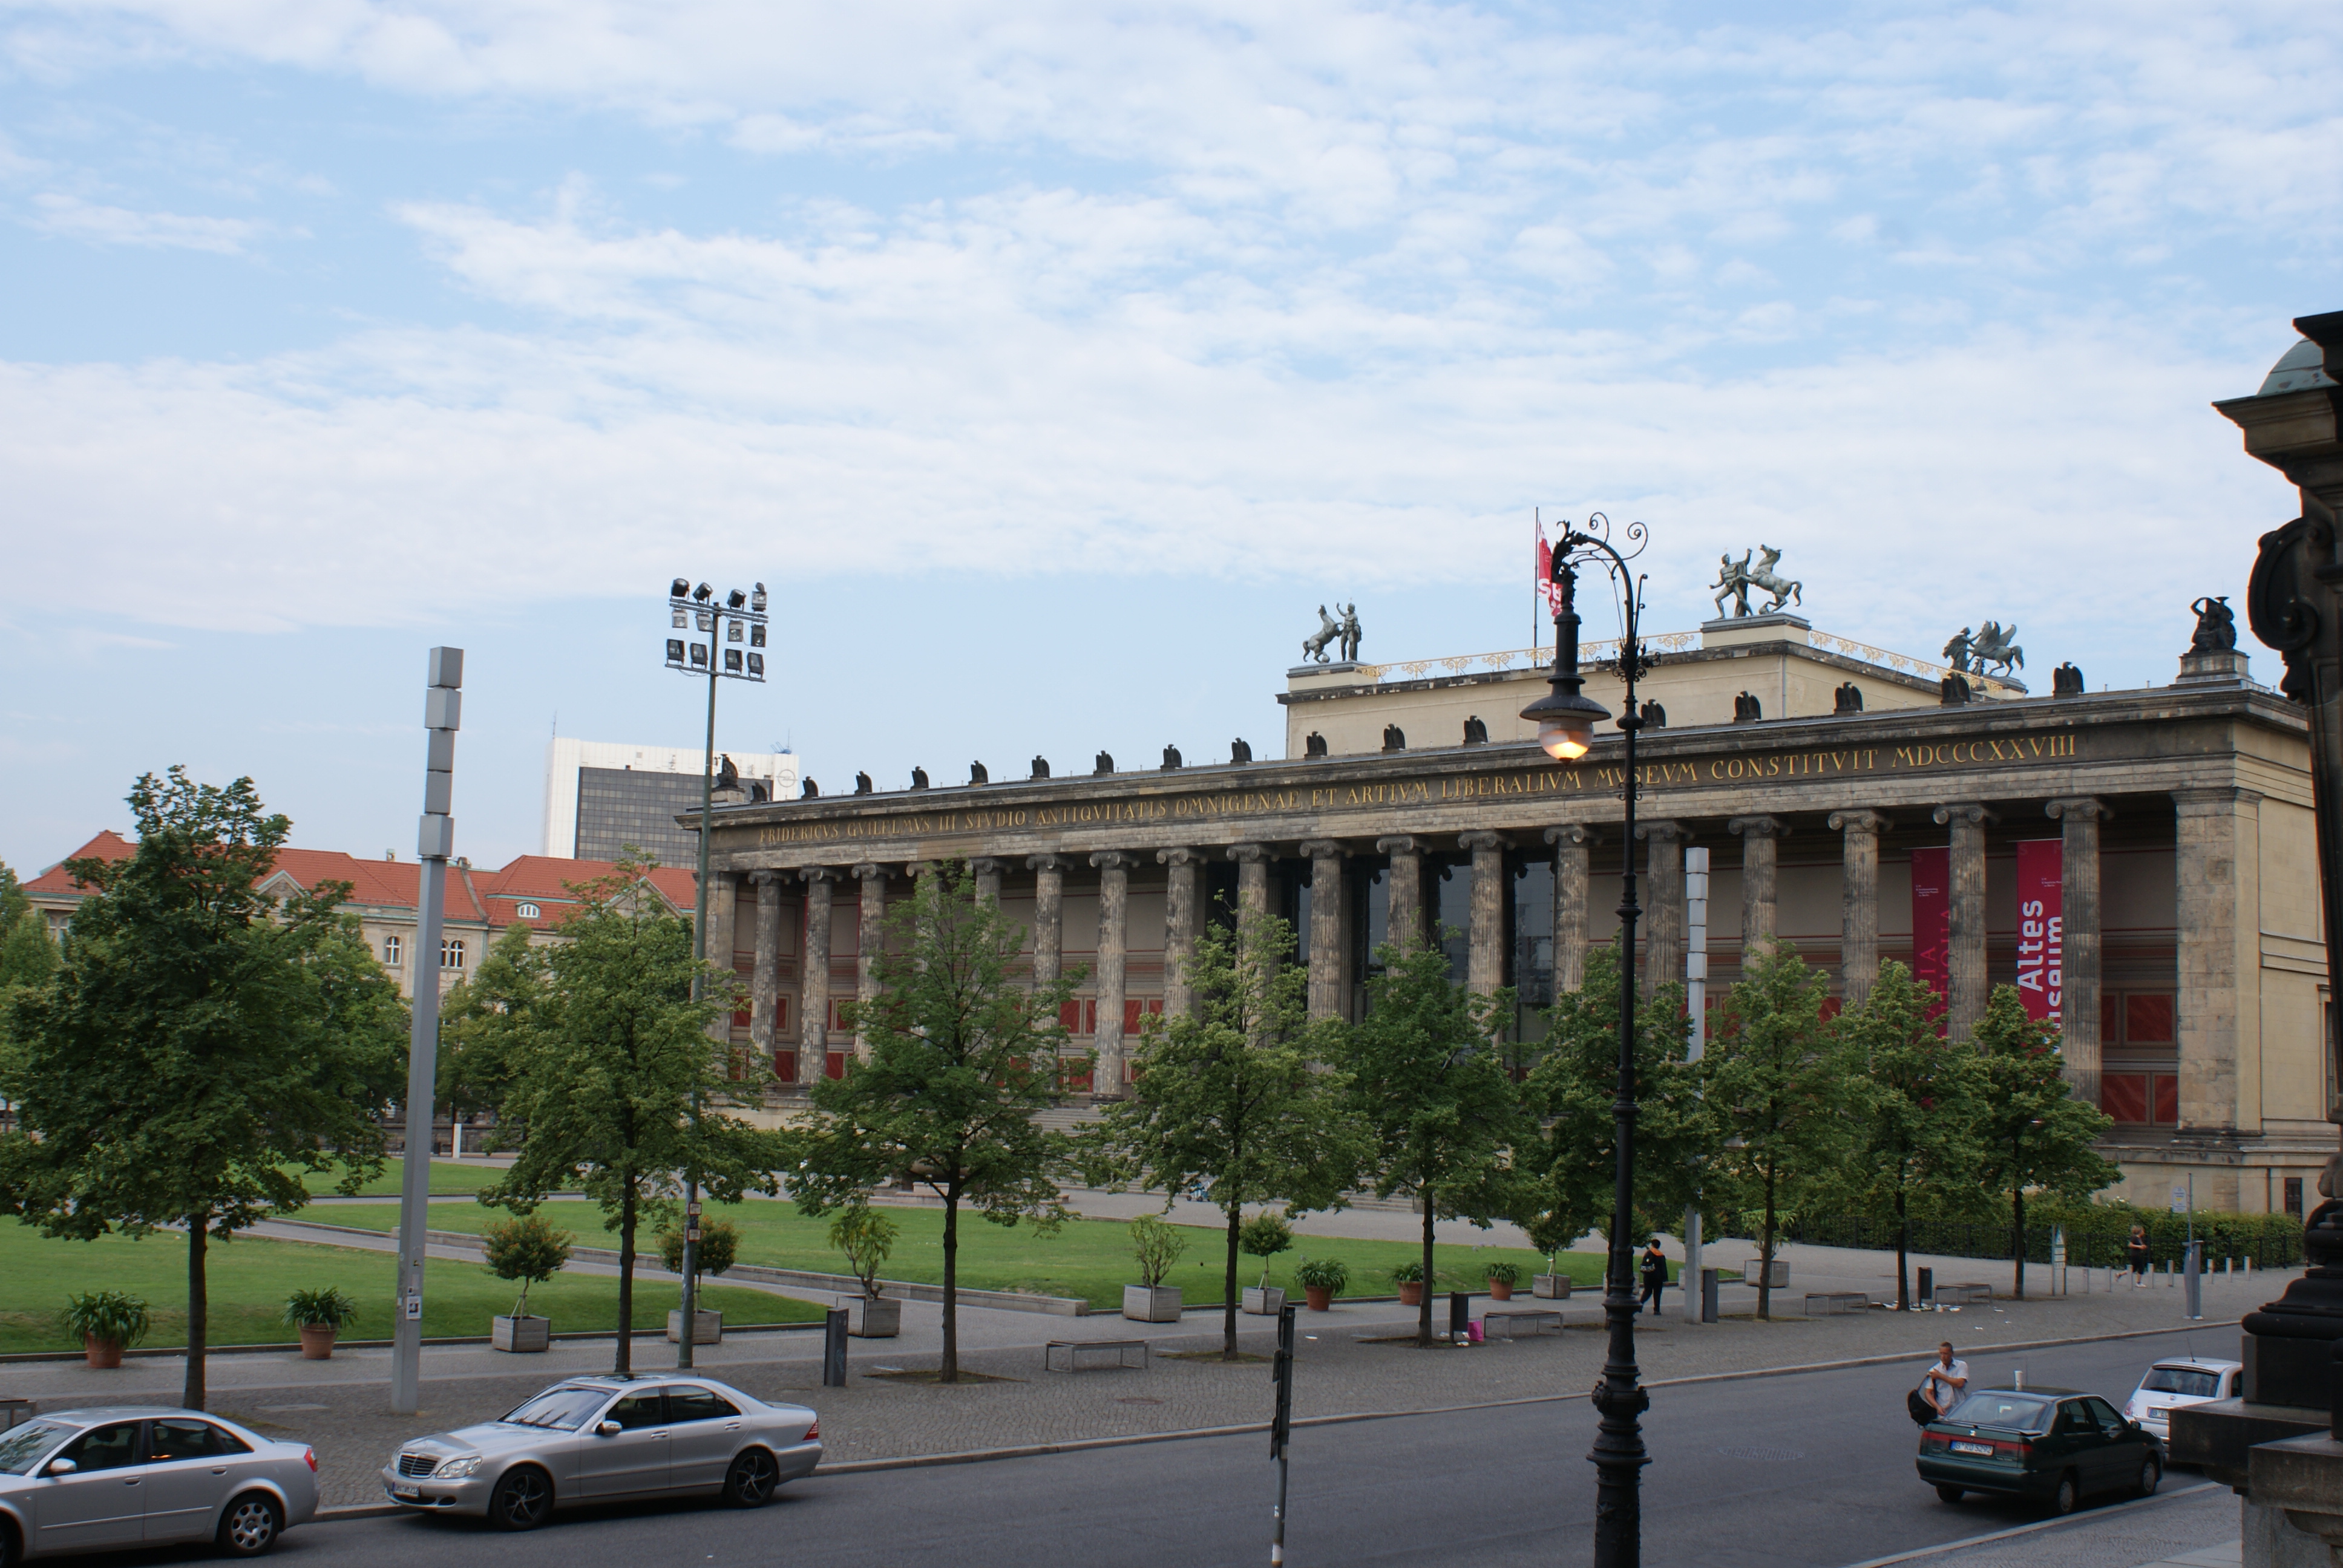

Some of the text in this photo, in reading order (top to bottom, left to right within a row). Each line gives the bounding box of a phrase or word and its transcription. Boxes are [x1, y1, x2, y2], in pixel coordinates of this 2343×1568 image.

[760, 823, 839, 843] FRIDERICVS
[847, 817, 931, 837] GVILELMVS
[939, 815, 956, 831] III
[965, 811, 1026, 829] STVDIO
[1035, 800, 1167, 825] ANTIQVITATIS
[1175, 789, 1301, 815] OMNIGENAE
[1312, 788, 1337, 807] ET
[1346, 781, 1430, 805] ARTIVM
[1441, 770, 1582, 799] LIBERALIVM
[1711, 749, 1878, 780] CONSTITVIT
[1892, 734, 2076, 768] MDCCCXXVIII
[2017, 900, 2044, 992] Altes
